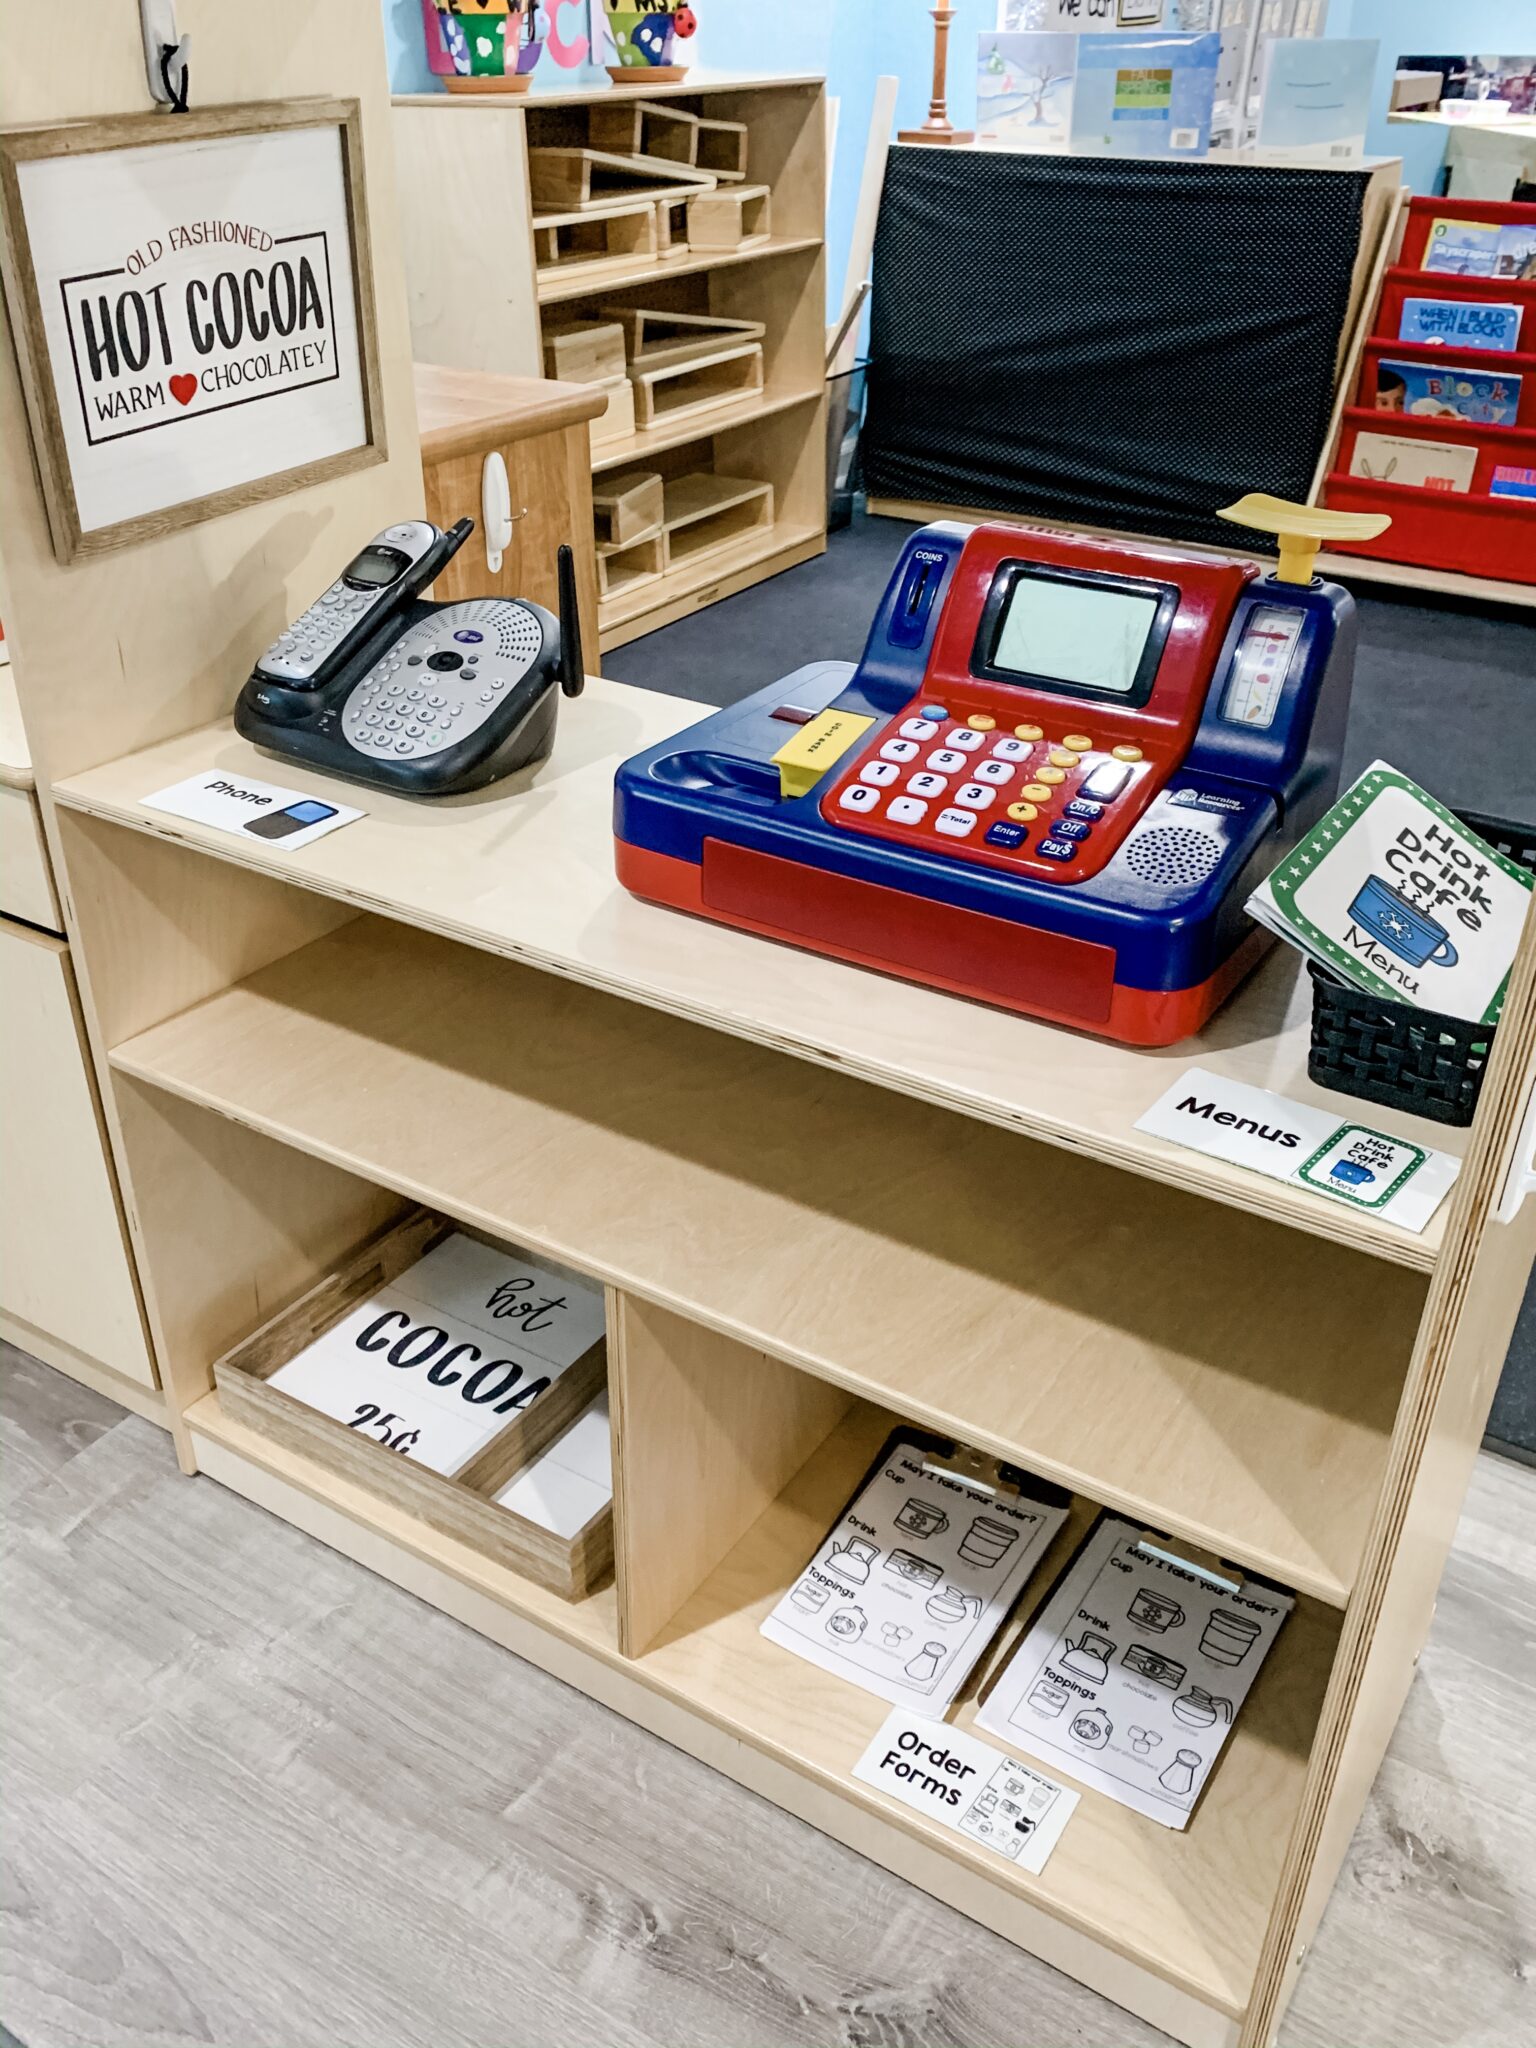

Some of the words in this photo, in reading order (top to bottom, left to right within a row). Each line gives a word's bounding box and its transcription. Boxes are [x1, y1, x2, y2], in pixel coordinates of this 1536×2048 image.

[126, 239, 163, 275] OLD
[169, 221, 273, 252] FASHIONED
[80, 282, 173, 382] HOT
[186, 256, 325, 355] COCOA
[1419, 307, 1458, 322] WHEN
[1461, 310, 1466, 322] I
[1468, 310, 1506, 324] BUILD
[1419, 319, 1454, 334] WITH
[1457, 322, 1507, 339] BLOCKS
[94, 382, 166, 422] WARM
[200, 340, 327, 393] CHOCOLATEY
[1427, 375, 1509, 402] Block
[915, 551, 943, 562] COINS
[914, 721, 928, 730] 7
[958, 732, 973, 741] 8
[1005, 742, 1020, 751] 9
[893, 743, 908, 752] 4
[939, 753, 955, 762] 5
[986, 764, 1002, 774] 6
[204, 780, 273, 806] Phone
[852, 789, 867, 800] 0
[877, 765, 888, 775] 1
[918, 776, 935, 787] 2
[967, 788, 983, 799] 3
[1201, 793, 1241, 807] Learning
[993, 825, 1020, 837] Enter
[1062, 822, 1081, 834] Off
[1042, 840, 1073, 855] Pay$
[1424, 824, 1490, 881] Hot
[1396, 827, 1492, 915] Drink
[1343, 925, 1420, 995] Menu
[1175, 1096, 1302, 1148] Menus
[1353, 1141, 1394, 1162] Drink
[1366, 1138, 1395, 1153] Hot
[1327, 1176, 1357, 1193] Menu
[485, 1278, 568, 1332] hot
[885, 1469, 906, 1485] Cup
[901, 1459, 925, 1478] May
[927, 1470, 935, 1481] I
[937, 1475, 963, 1493] take
[966, 1490, 993, 1506] your
[995, 1503, 1037, 1523] order?
[847, 1515, 878, 1537] Drink
[1110, 1557, 1133, 1573] Cup
[808, 1566, 857, 1600] Toppings
[1126, 1546, 1154, 1565] May
[1156, 1559, 1164, 1569] I
[1167, 1564, 1195, 1583] take
[1199, 1579, 1228, 1597] your
[1232, 1595, 1279, 1617] order?
[1077, 1609, 1110, 1631] Drink
[1041, 1686, 1062, 1701] Sugar
[1043, 1666, 1097, 1701] Toppings
[1122, 1682, 1157, 1701] chocolate
[898, 1731, 976, 1780] Order
[879, 1751, 962, 1806] Forms
